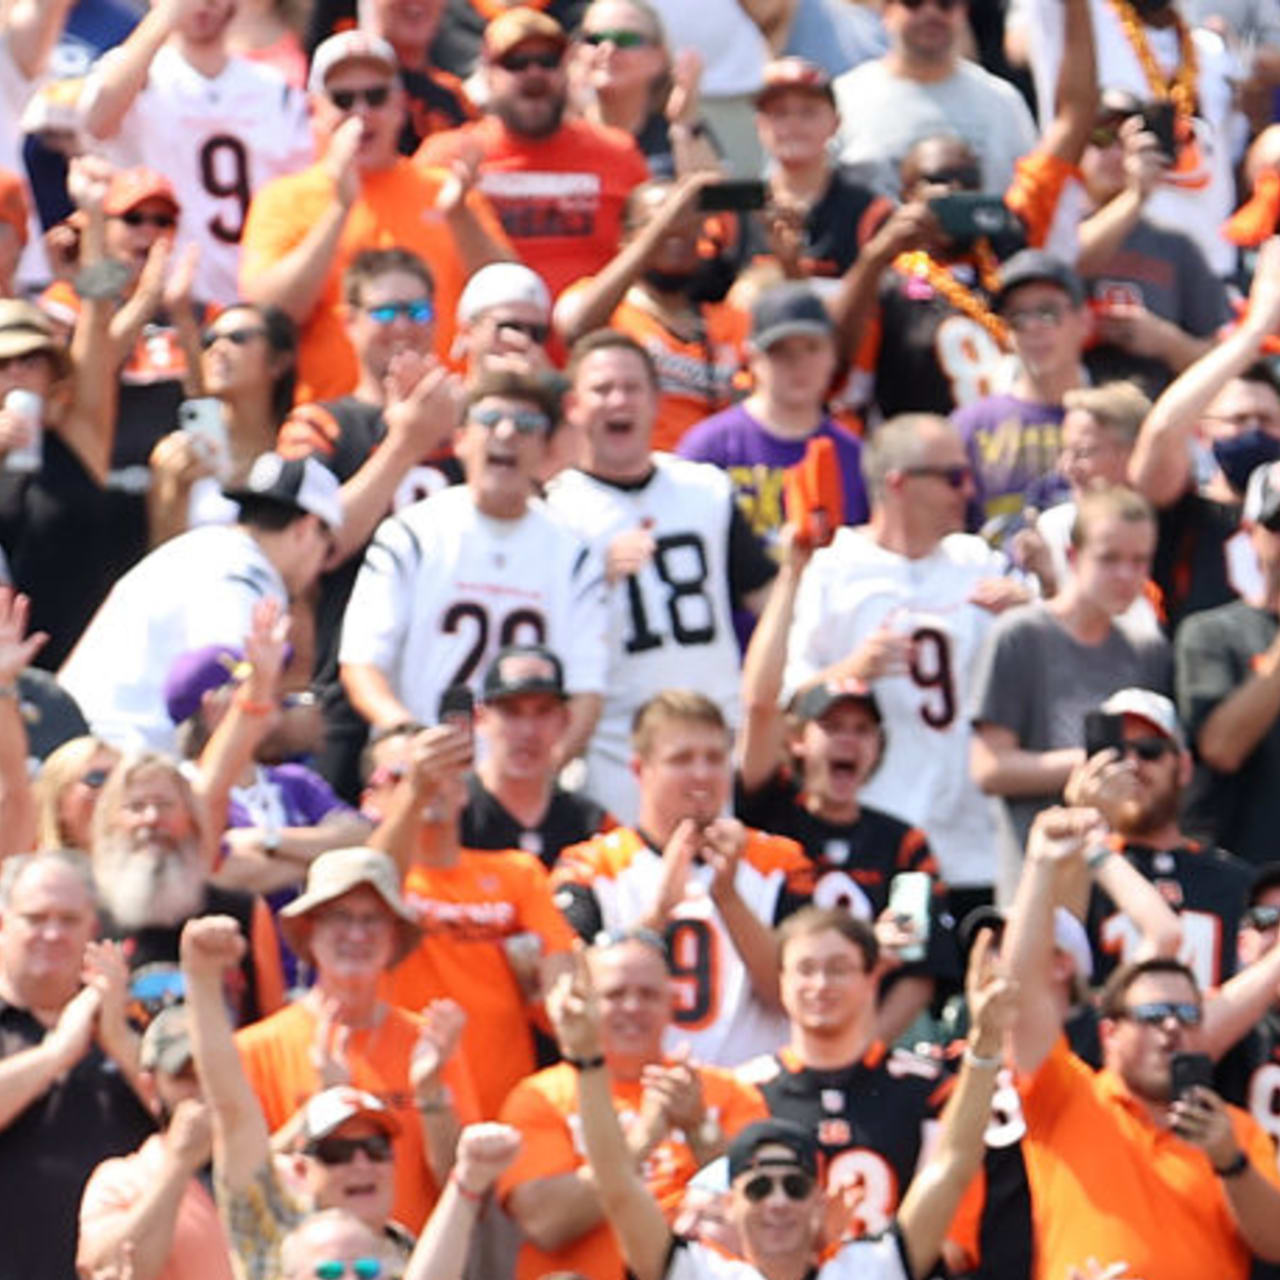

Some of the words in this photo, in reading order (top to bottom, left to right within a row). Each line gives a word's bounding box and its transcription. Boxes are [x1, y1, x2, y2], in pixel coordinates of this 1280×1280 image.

[200, 134, 251, 244] 9
[624, 531, 716, 655] 18
[909, 627, 956, 729] 9
[665, 917, 720, 1031] 9
